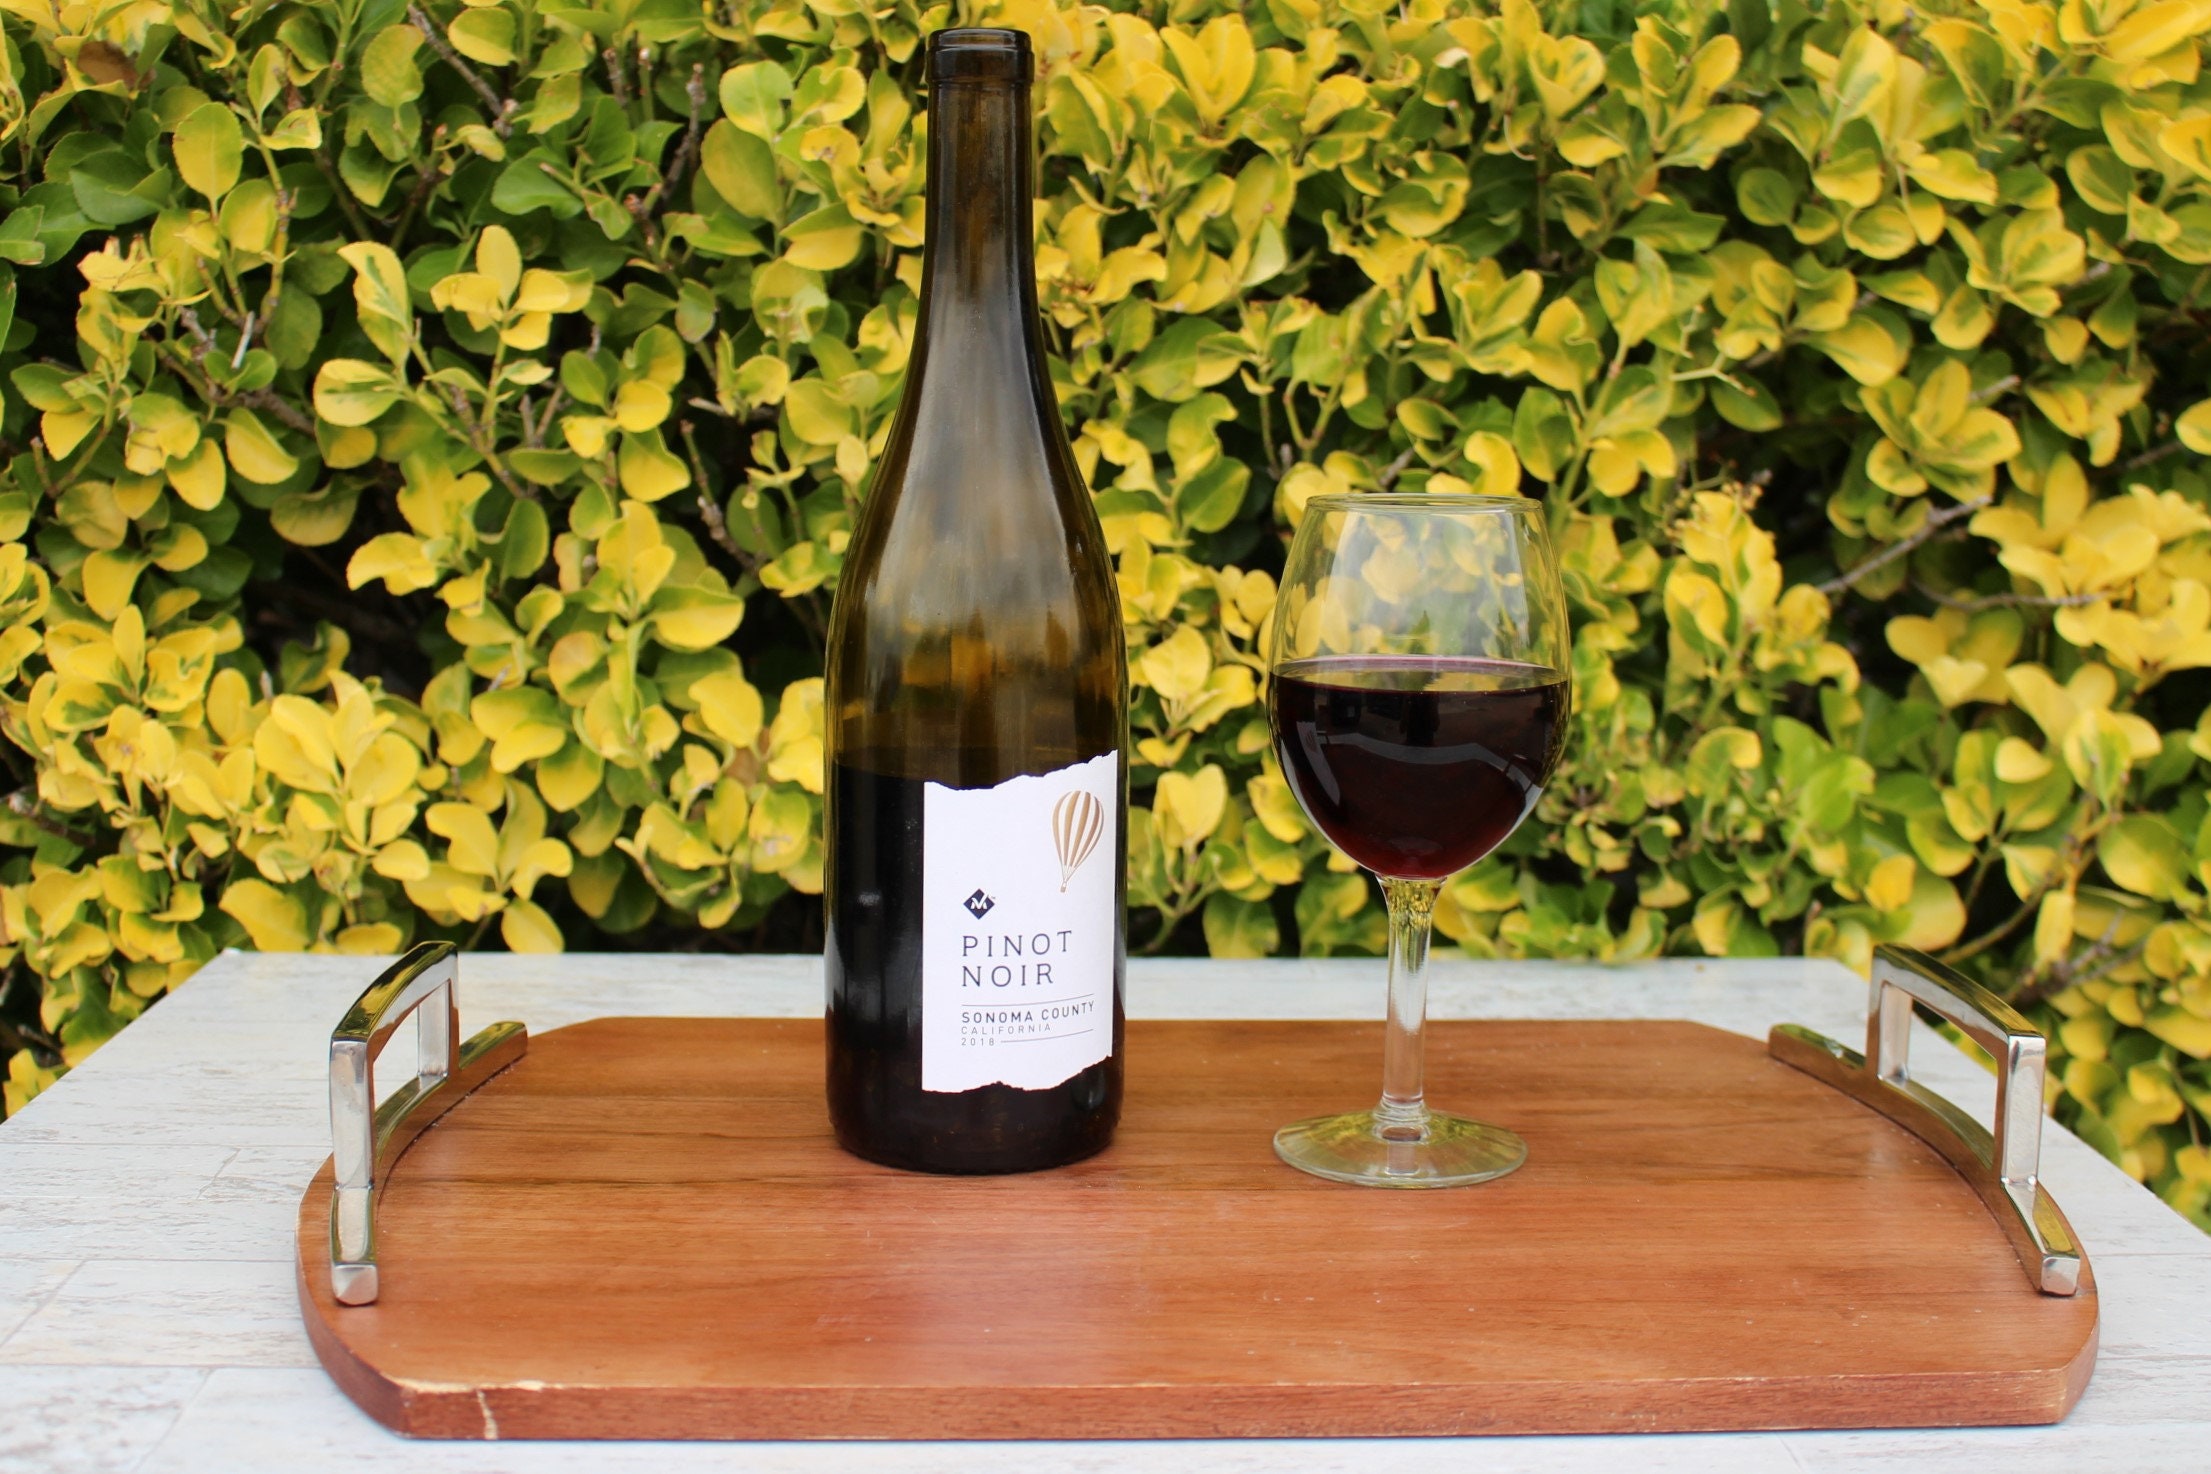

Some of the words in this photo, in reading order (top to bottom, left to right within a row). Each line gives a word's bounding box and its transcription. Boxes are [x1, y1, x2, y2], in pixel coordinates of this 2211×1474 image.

[962, 930, 1073, 957] PINOT
[962, 963, 1054, 987] NOIR
[961, 1011, 1034, 1024] SONOMA
[1041, 1000, 1096, 1021] COUNTY
[961, 1023, 1052, 1035] CALIFORNIA
[961, 1037, 995, 1047] 2018
